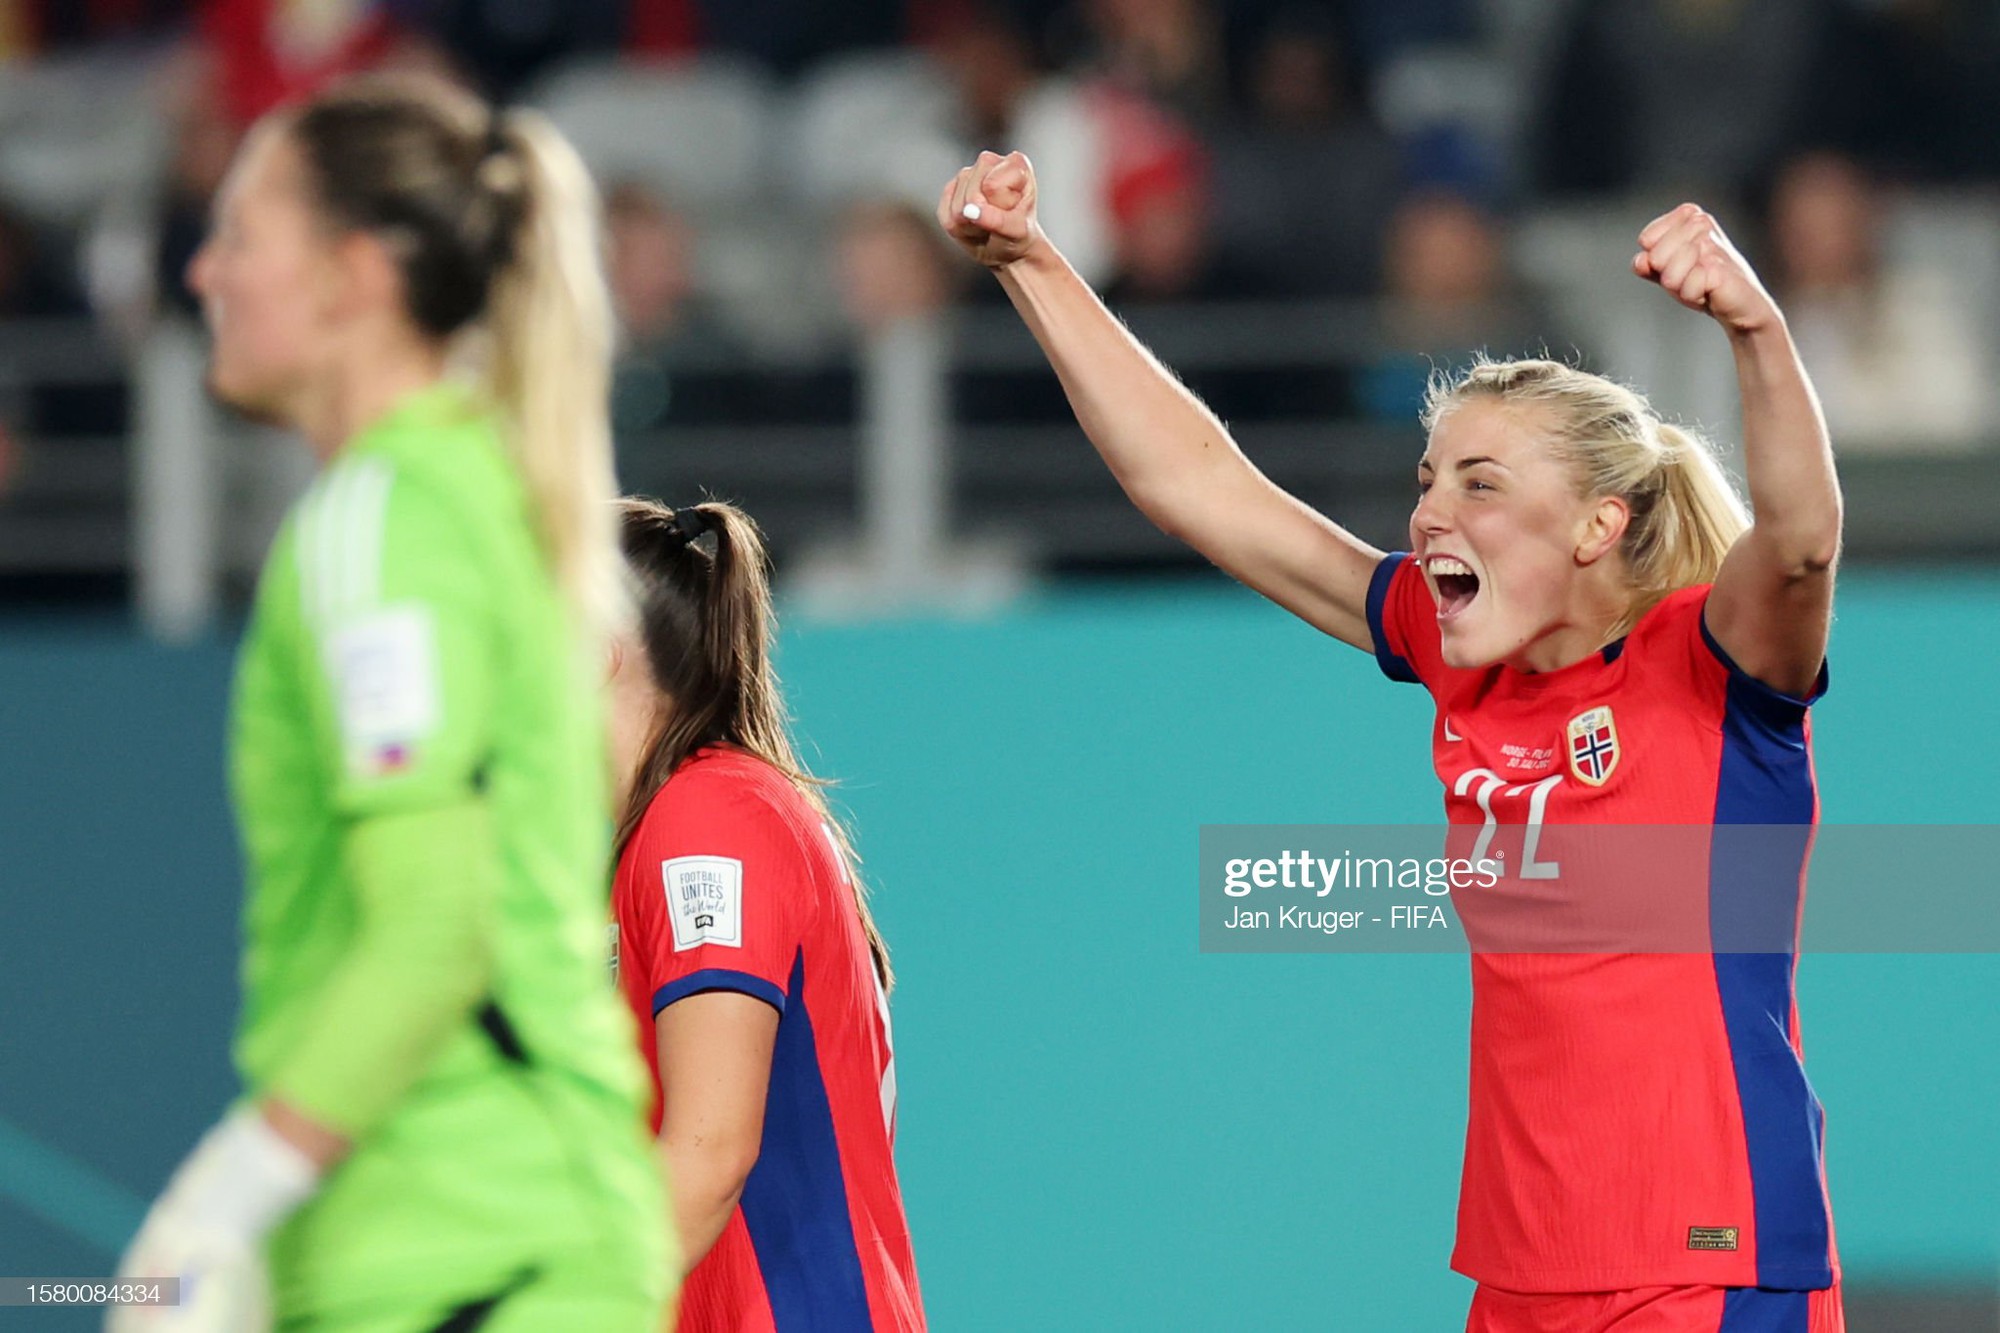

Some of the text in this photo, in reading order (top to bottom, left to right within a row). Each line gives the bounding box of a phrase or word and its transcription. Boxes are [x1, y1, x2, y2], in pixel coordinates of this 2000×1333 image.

[1454, 768, 1563, 879] 22
[679, 870, 723, 885] FOOTBALL
[681, 883, 724, 901] UNITES
[682, 899, 727, 917] the World
